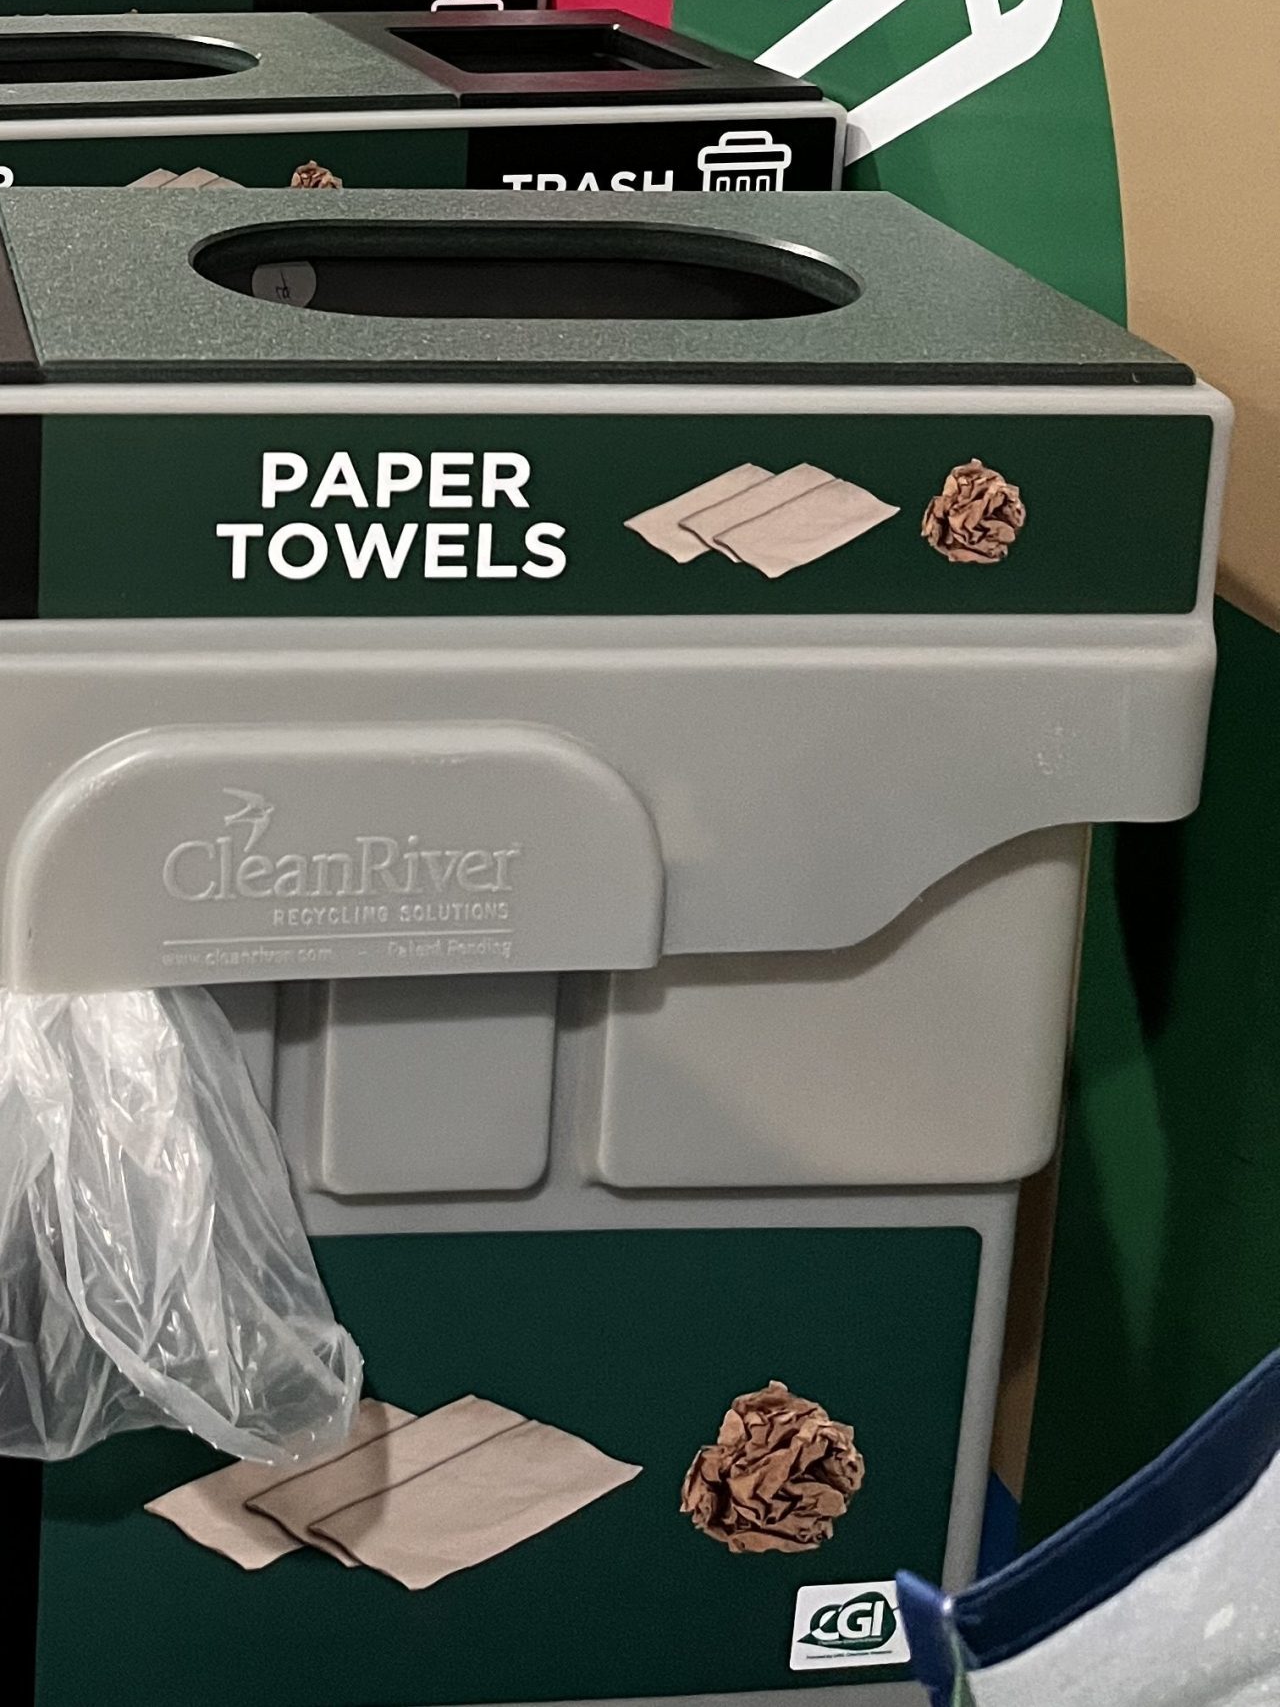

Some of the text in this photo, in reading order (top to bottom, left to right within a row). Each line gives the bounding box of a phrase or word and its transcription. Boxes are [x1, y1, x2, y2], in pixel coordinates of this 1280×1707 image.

[261, 451, 531, 509] PAPER
[216, 522, 568, 580] TOWELS
[163, 834, 520, 902] CleanRiver
[272, 901, 509, 927] RECYCLING SOLUTIONS
[809, 1599, 885, 1642] CGI
